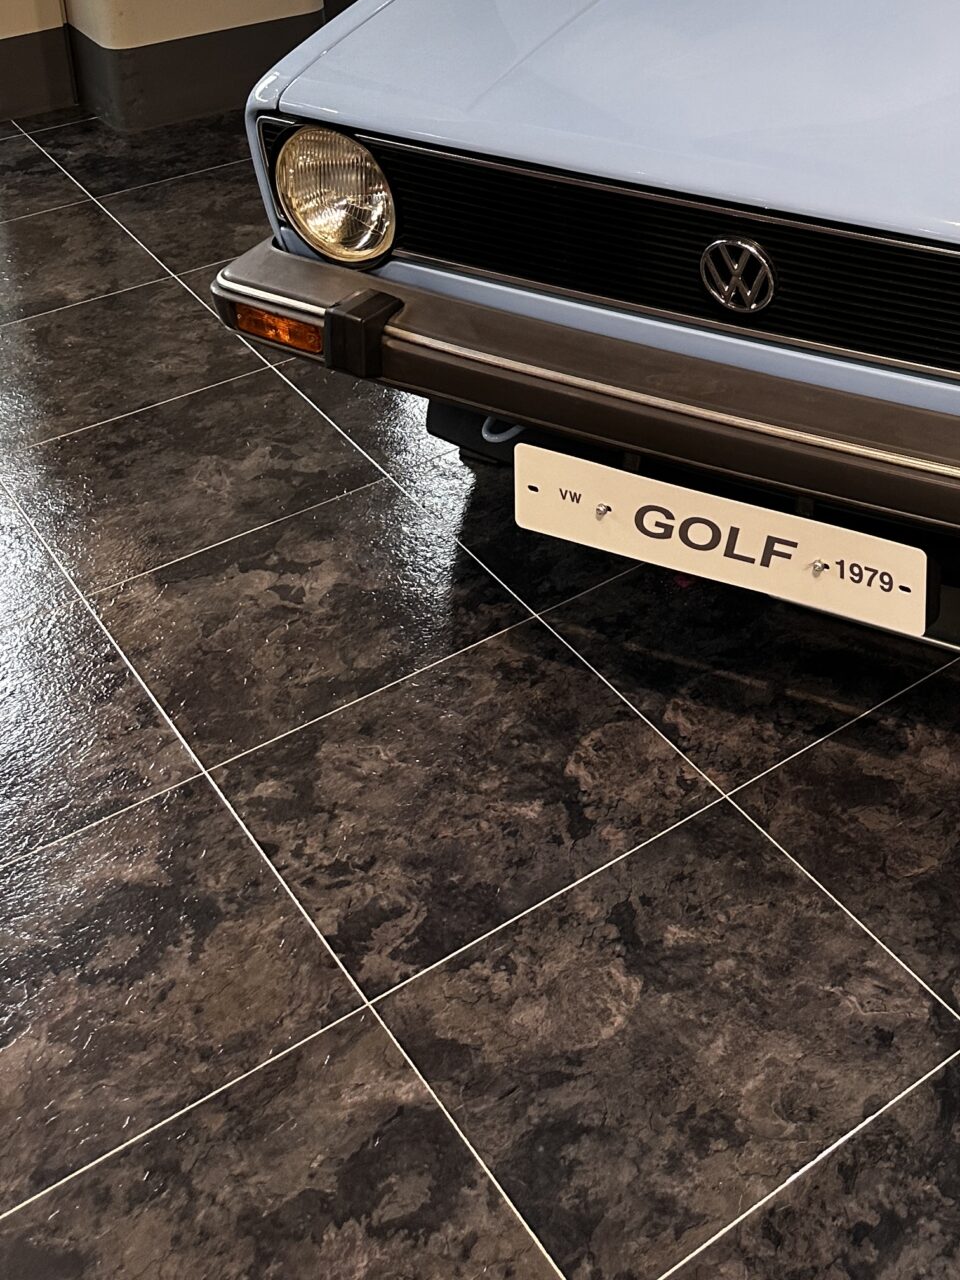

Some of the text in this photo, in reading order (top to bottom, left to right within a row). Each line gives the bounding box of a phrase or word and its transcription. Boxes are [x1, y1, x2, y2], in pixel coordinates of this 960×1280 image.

[559, 488, 894, 593] VW GOLF 1979
